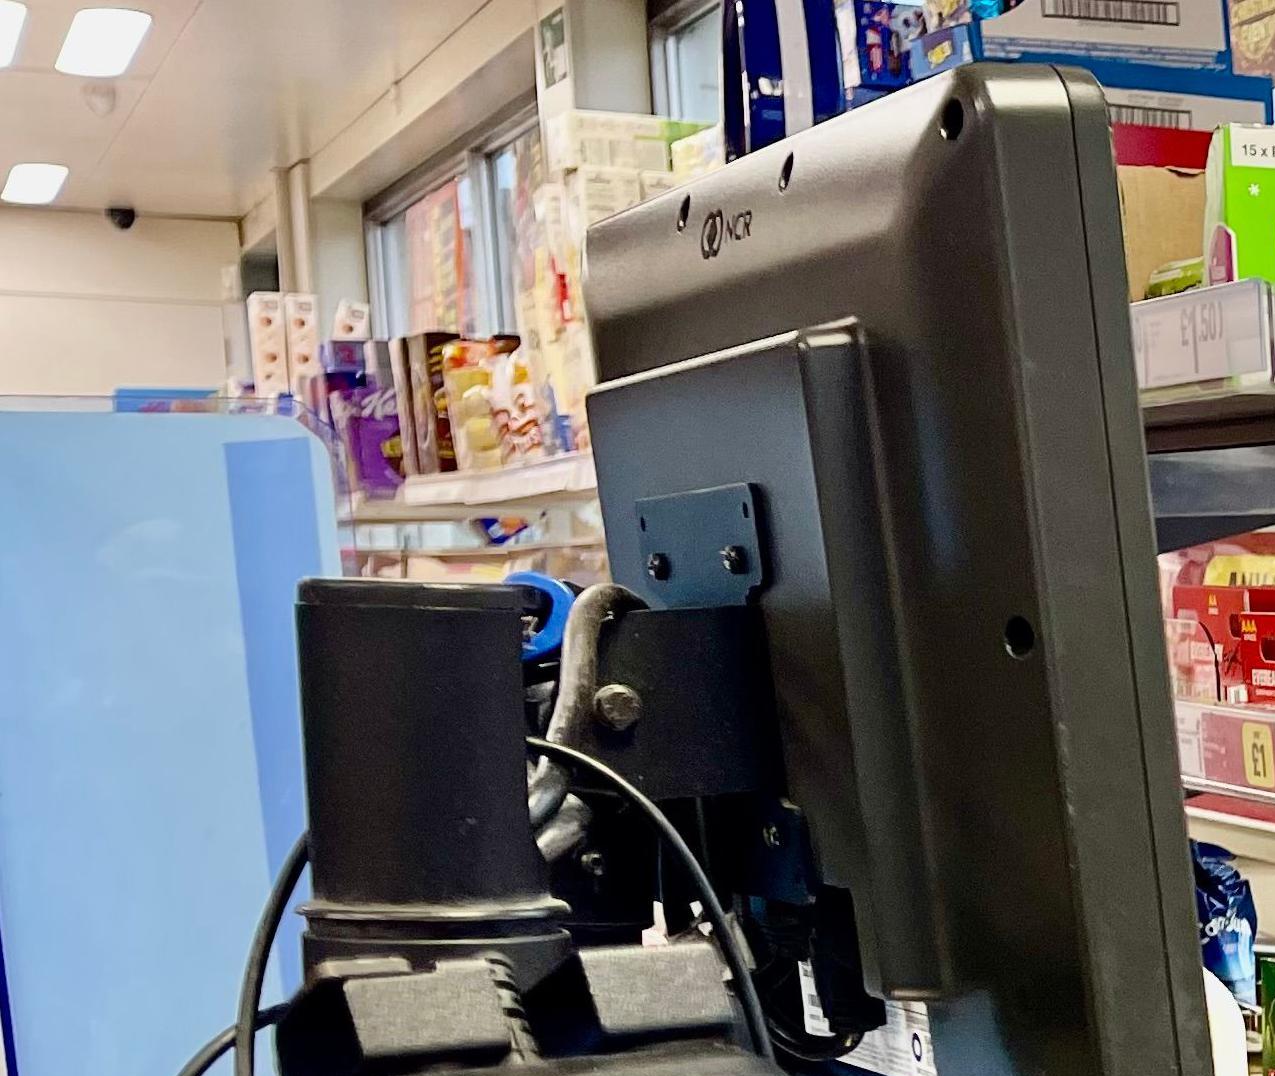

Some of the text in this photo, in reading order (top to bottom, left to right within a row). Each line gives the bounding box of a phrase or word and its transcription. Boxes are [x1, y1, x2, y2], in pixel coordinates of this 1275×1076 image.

[1242, 145, 1257, 157] 15
[1261, 149, 1268, 157] x
[724, 209, 752, 243] NCR
[1253, 744, 1267, 778] £1
